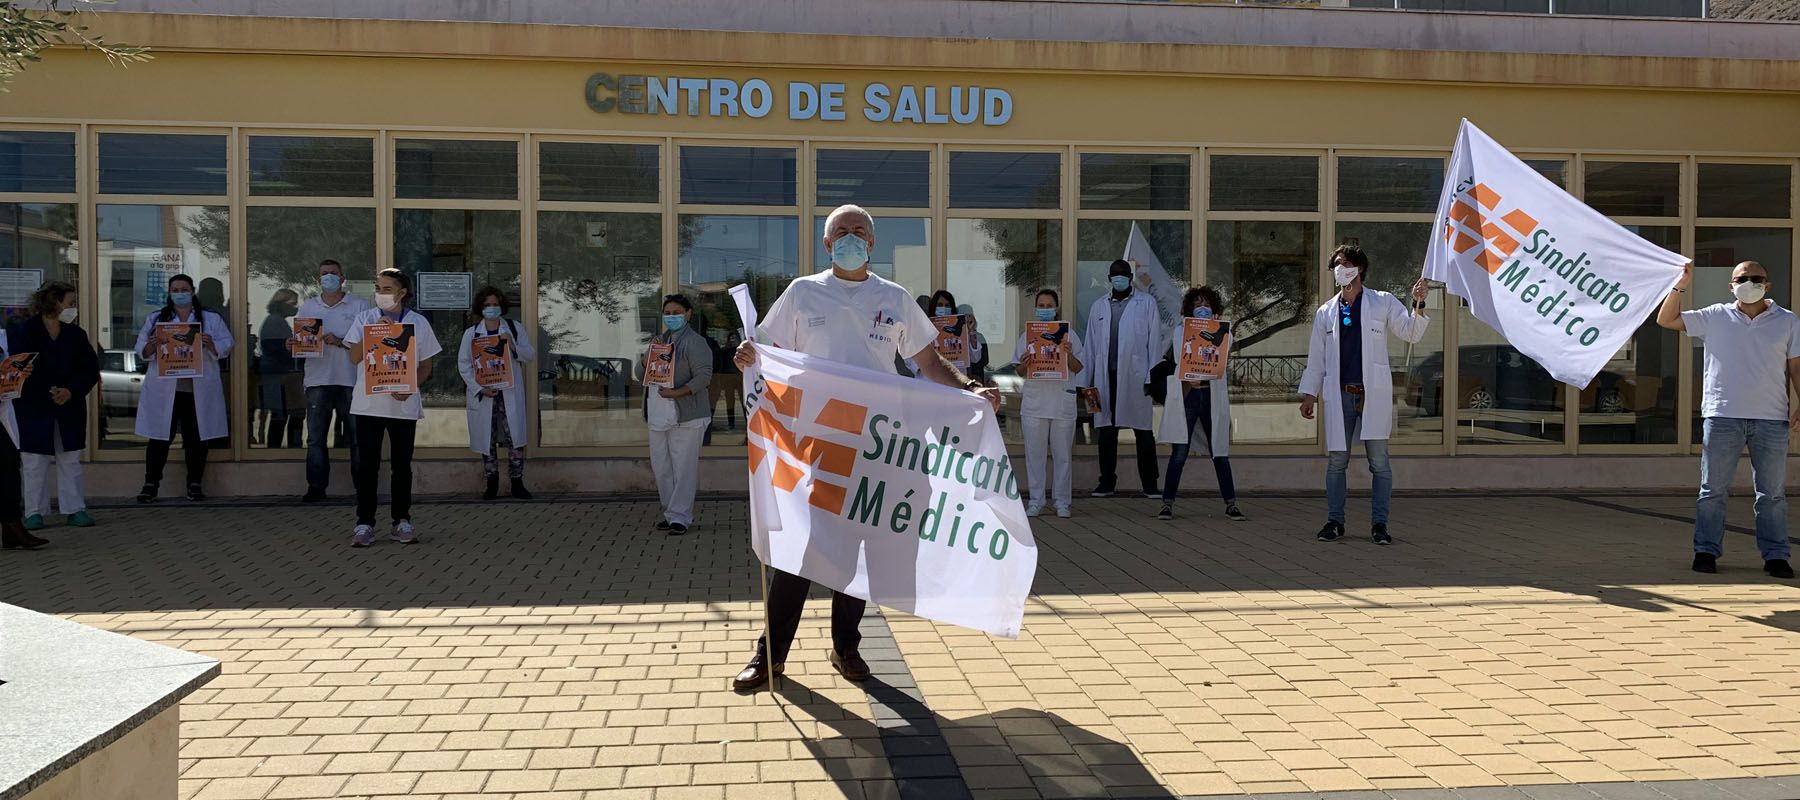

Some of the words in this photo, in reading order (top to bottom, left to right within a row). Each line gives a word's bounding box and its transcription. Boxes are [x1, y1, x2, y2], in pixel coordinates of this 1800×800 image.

[585, 73, 773, 119] CENTRO
[788, 82, 846, 121] DE
[863, 84, 1014, 126] SALUD
[1497, 260, 1600, 346] Médico
[1523, 229, 1630, 313] Sindicato
[863, 414, 1020, 501] Sindicato
[847, 477, 1010, 561] Médico
